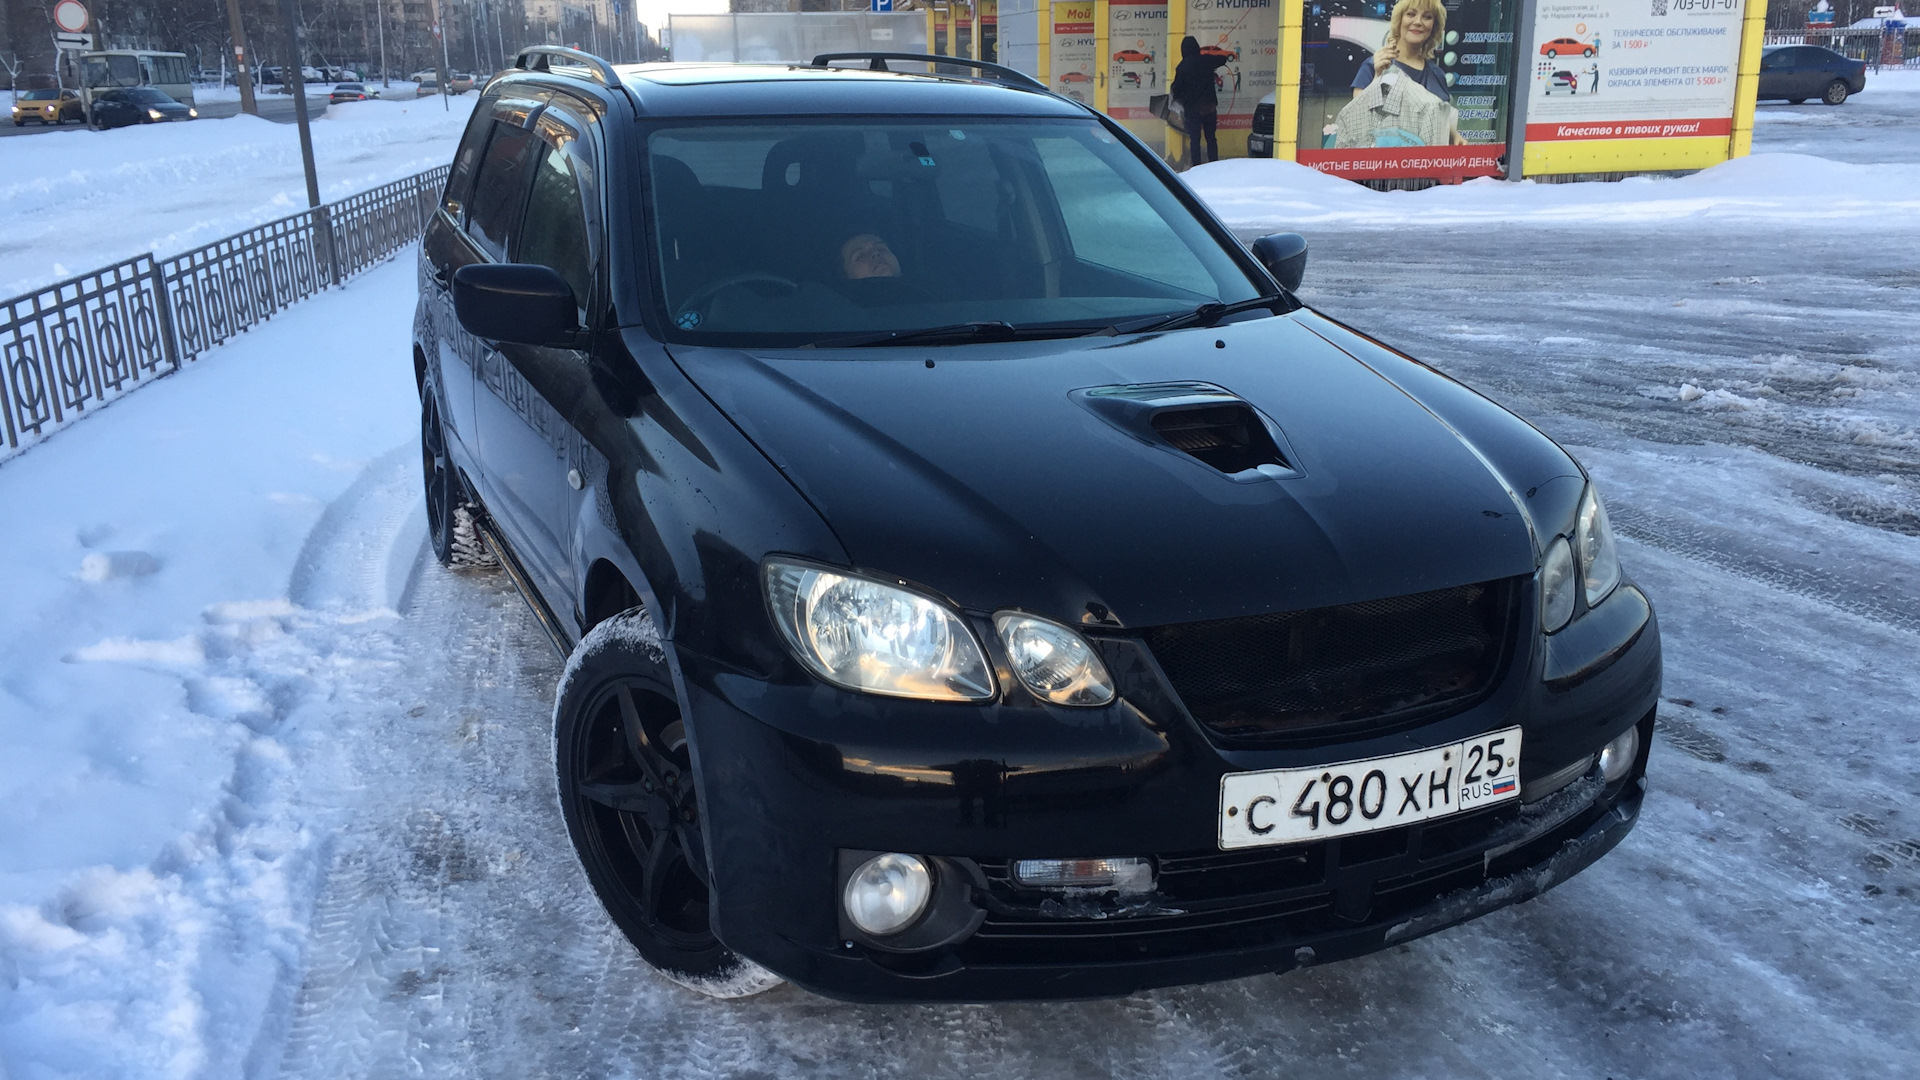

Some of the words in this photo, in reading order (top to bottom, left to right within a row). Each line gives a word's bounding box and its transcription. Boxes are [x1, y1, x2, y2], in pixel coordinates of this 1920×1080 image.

[1216, 0, 1270, 8] HYUNDAI
[1067, 8, 1091, 19] Мой
[1613, 29, 1665, 37] ТЕХНИЧЕСКОЕ
[1666, 27, 1727, 36] ОБСЛУЖИВАНИЕ
[1612, 41, 1621, 49] ЗА
[1460, 54, 1496, 64] СТИРКА
[1609, 66, 1648, 76] КУЗОВНОЙ
[1649, 67, 1680, 75] РЕМОНТ
[1682, 66, 1701, 74] ВСЕХ
[1702, 66, 1729, 74] МАРОК
[1608, 79, 1641, 88] ОКРАСКА
[1643, 78, 1684, 87] ЭЛЕМЕНТА
[1685, 77, 1695, 85] ОТ
[1457, 96, 1496, 106] РЕМОНТ
[1458, 109, 1498, 120] ОДЕЖДЫ
[1557, 125, 1612, 137] Качество
[1615, 127, 1622, 135] в
[1624, 124, 1660, 135] твоих
[1662, 121, 1700, 136] руках!
[1308, 160, 1350, 171] ЧИСТЫЕ
[1353, 160, 1383, 171] ВЕЩИ
[1385, 159, 1399, 169] НА
[1400, 156, 1467, 170] СЛЕДУЮЩИЙ
[1468, 157, 1496, 169] ДЕНЬ
[1465, 738, 1505, 785] 25
[1461, 783, 1492, 802] RUS
